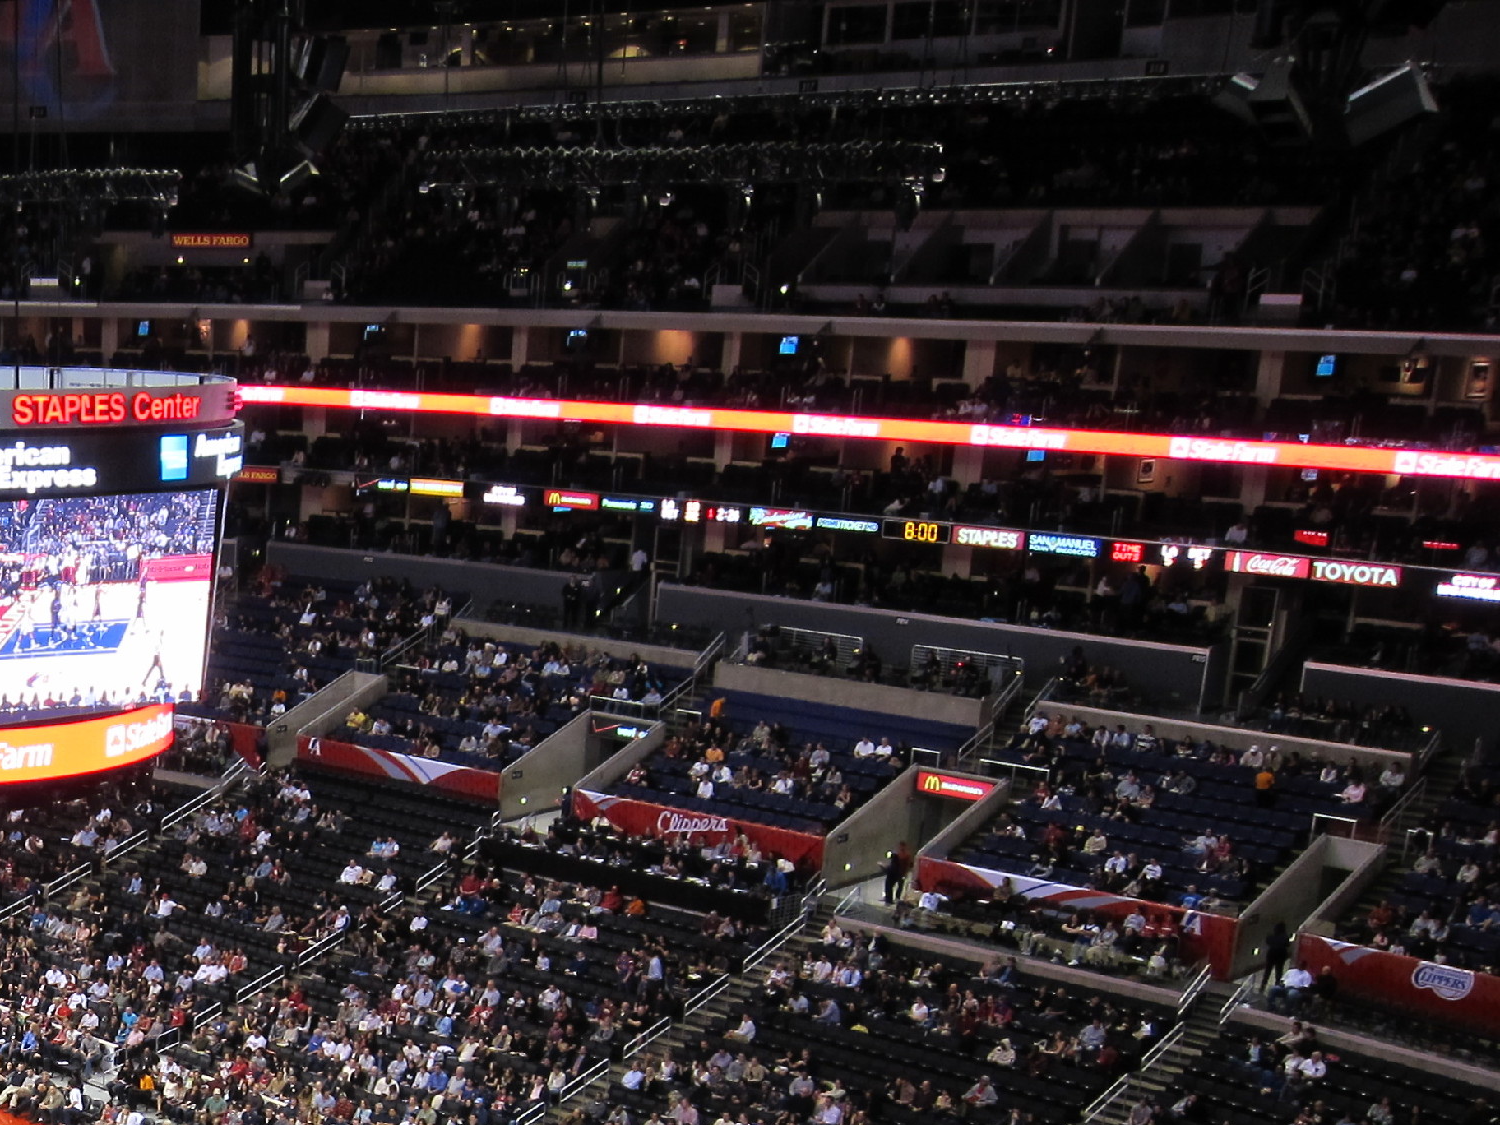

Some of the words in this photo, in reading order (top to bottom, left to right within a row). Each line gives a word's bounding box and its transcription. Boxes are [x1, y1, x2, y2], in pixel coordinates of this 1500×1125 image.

[173, 236, 210, 245] WELLS
[212, 236, 249, 246] FARGO
[13, 394, 127, 424] STAPLES
[133, 393, 200, 421] Center
[958, 528, 1019, 549] STAPLES
[1029, 534, 1049, 546] SAN
[1057, 537, 1097, 550] MANUEL
[1113, 543, 1141, 554] TIME
[1112, 552, 1140, 562] OUTS
[1312, 560, 1397, 586] TOYOTA
[657, 811, 729, 839] Clippers
[1413, 964, 1469, 992] CLIPPERS
